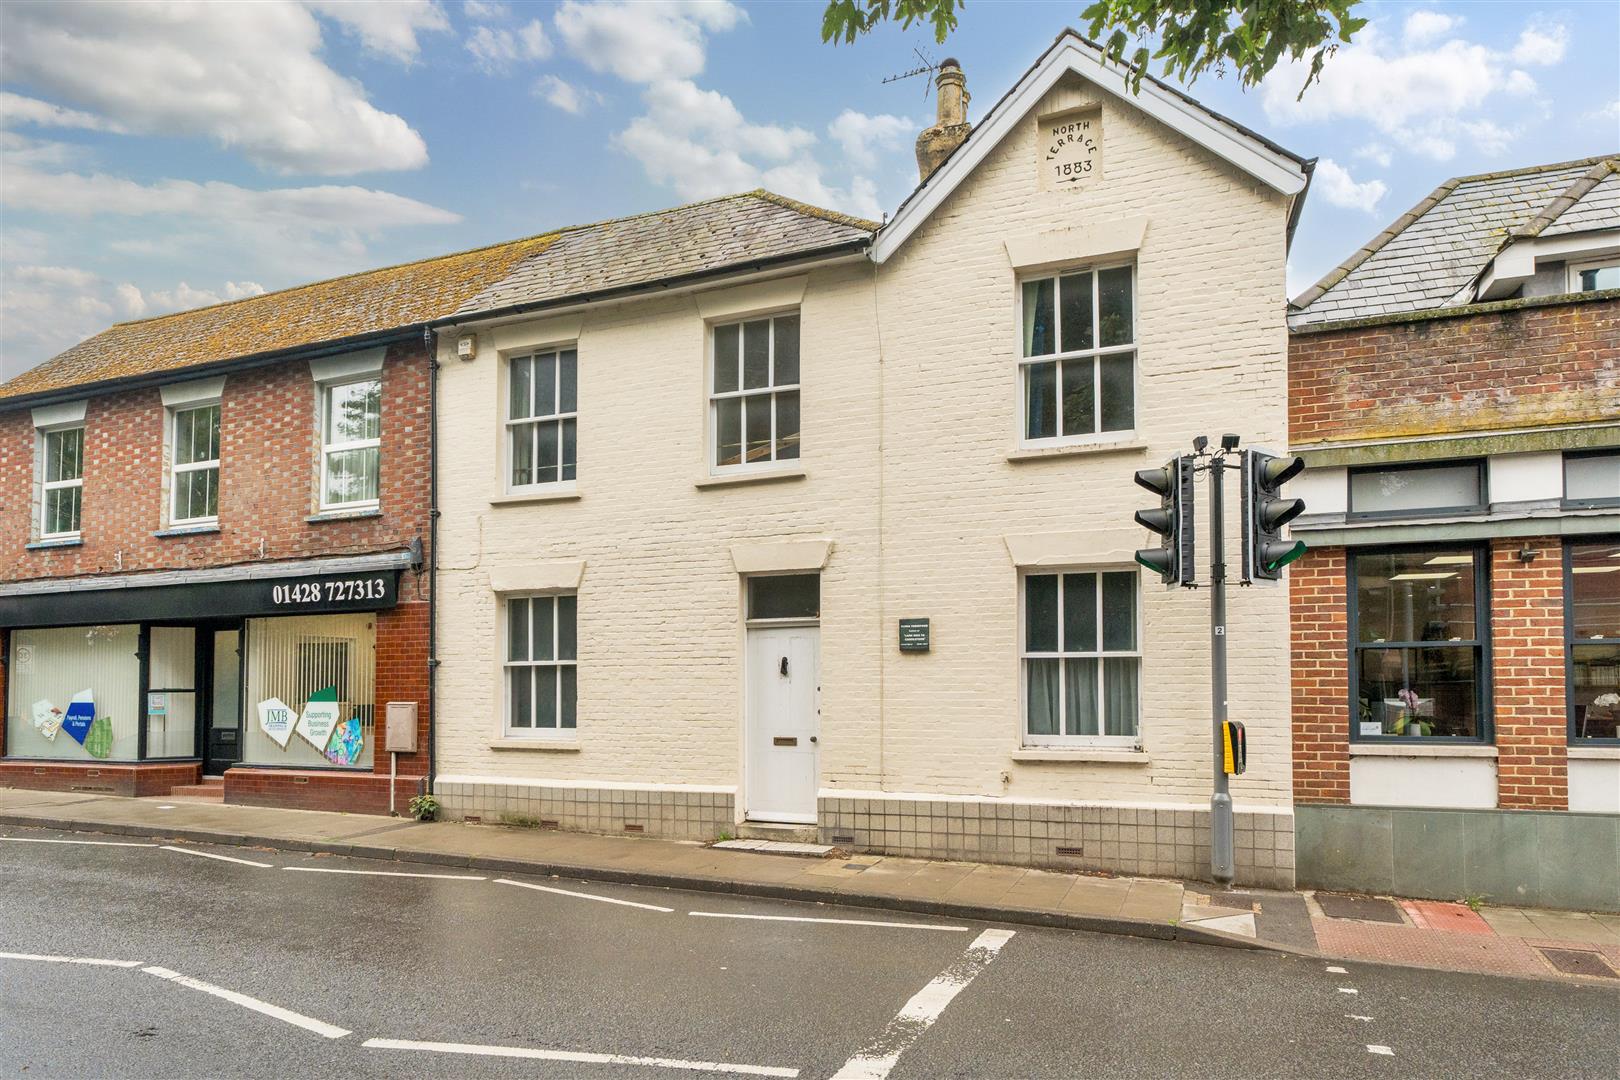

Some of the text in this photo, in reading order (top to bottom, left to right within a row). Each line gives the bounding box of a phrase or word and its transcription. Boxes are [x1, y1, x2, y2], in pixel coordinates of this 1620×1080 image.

[1052, 121, 1090, 136] NORTH
[1046, 134, 1097, 160] TERRACE
[1054, 160, 1092, 176] 1883
[272, 578, 385, 604] 01428 727313
[265, 709, 288, 725] JMB
[306, 711, 332, 720] Supporting
[308, 720, 330, 728] Business
